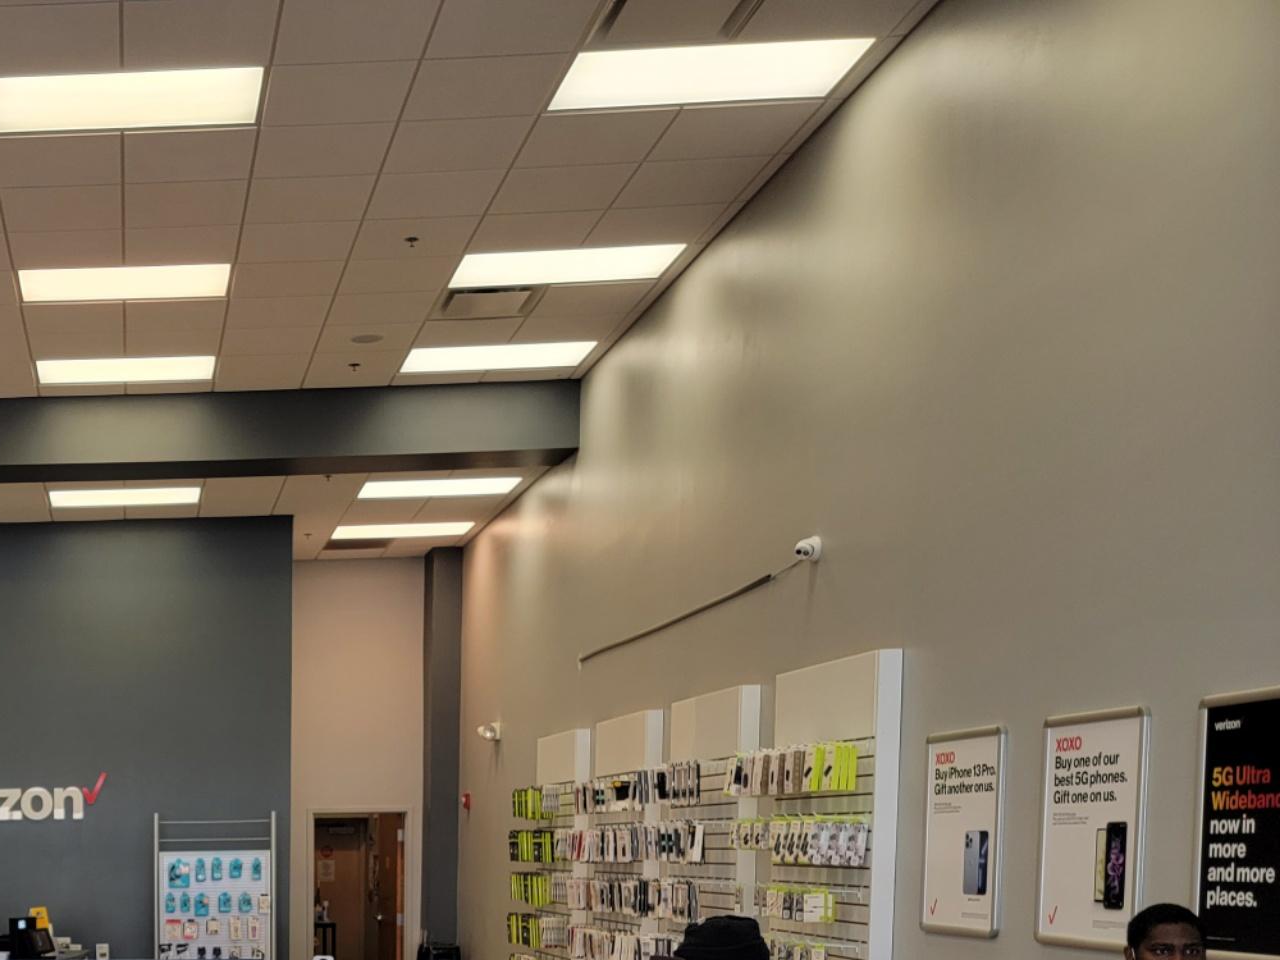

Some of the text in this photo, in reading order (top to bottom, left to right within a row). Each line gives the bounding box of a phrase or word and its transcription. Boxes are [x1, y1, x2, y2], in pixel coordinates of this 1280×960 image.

[1215, 718, 1241, 731] verizon
[1056, 736, 1082, 752] XOXO
[936, 751, 956, 766] XOXO
[1055, 752, 1120, 772] Buy one of our
[935, 768, 947, 781] Buy
[948, 766, 972, 779] iPhone
[974, 764, 981, 777] 13
[1054, 770, 1128, 788] best 5G phones.
[1212, 765, 1271, 787] 5G Ultra
[934, 783, 946, 795] Gift
[947, 781, 973, 795] another
[974, 783, 983, 793] on
[1053, 790, 1117, 804] Gift one on us.
[1210, 814, 1255, 834] now in
[1209, 843, 1246, 859] more
[1207, 863, 1275, 884] and more
[1206, 886, 1257, 909] places.
